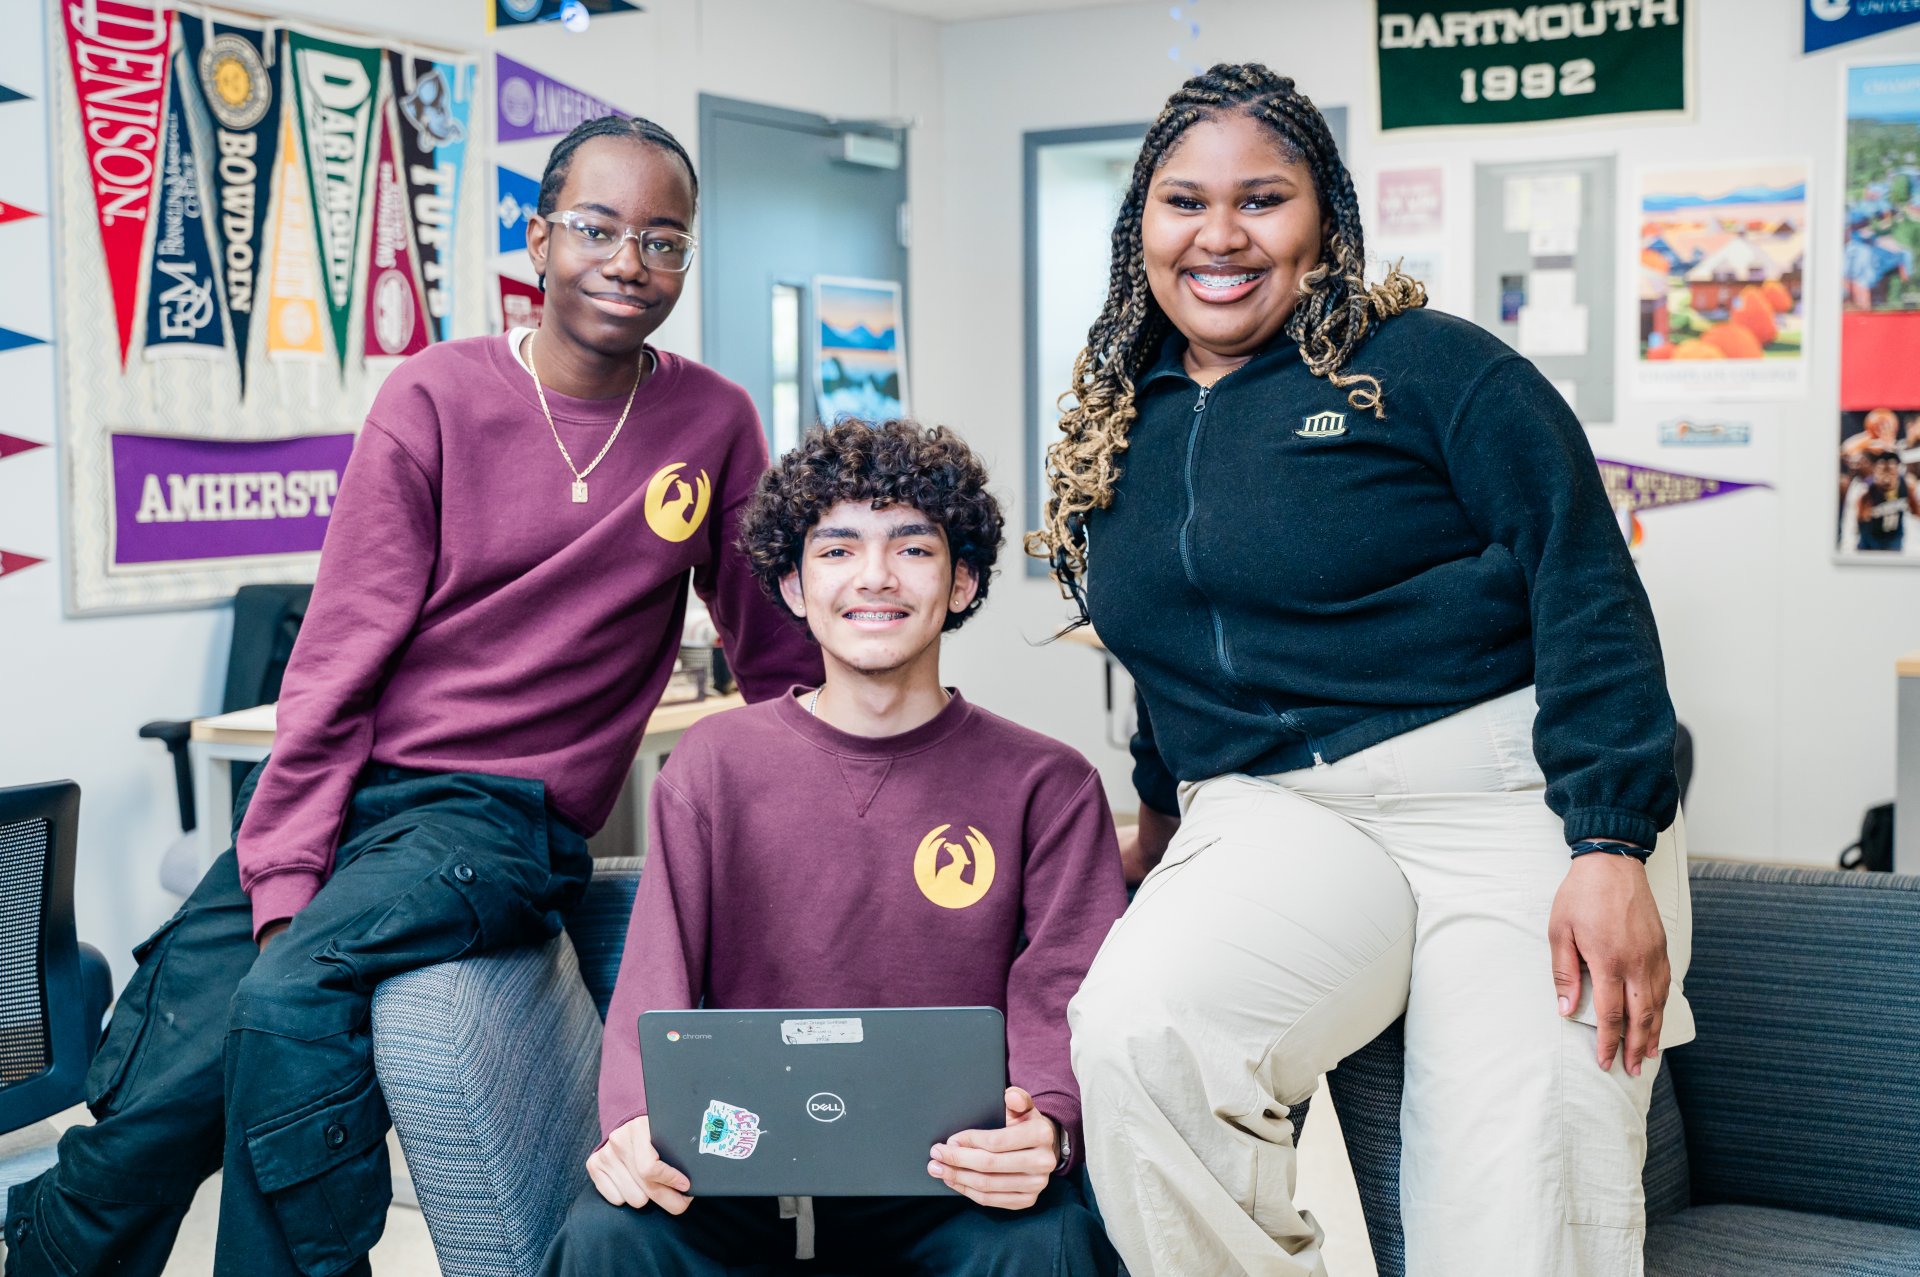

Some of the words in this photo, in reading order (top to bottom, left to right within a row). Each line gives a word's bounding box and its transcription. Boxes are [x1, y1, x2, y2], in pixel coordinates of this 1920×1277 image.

[1380, 0, 1679, 48] DARTMOUTH
[1460, 58, 1596, 103] 1992
[303, 50, 371, 307] DARTMOUTH
[217, 130, 258, 313] BOWDOIN
[410, 163, 456, 317] TUFTS
[136, 469, 338, 523] AMHERST
[811, 1103, 841, 1111] DELL
